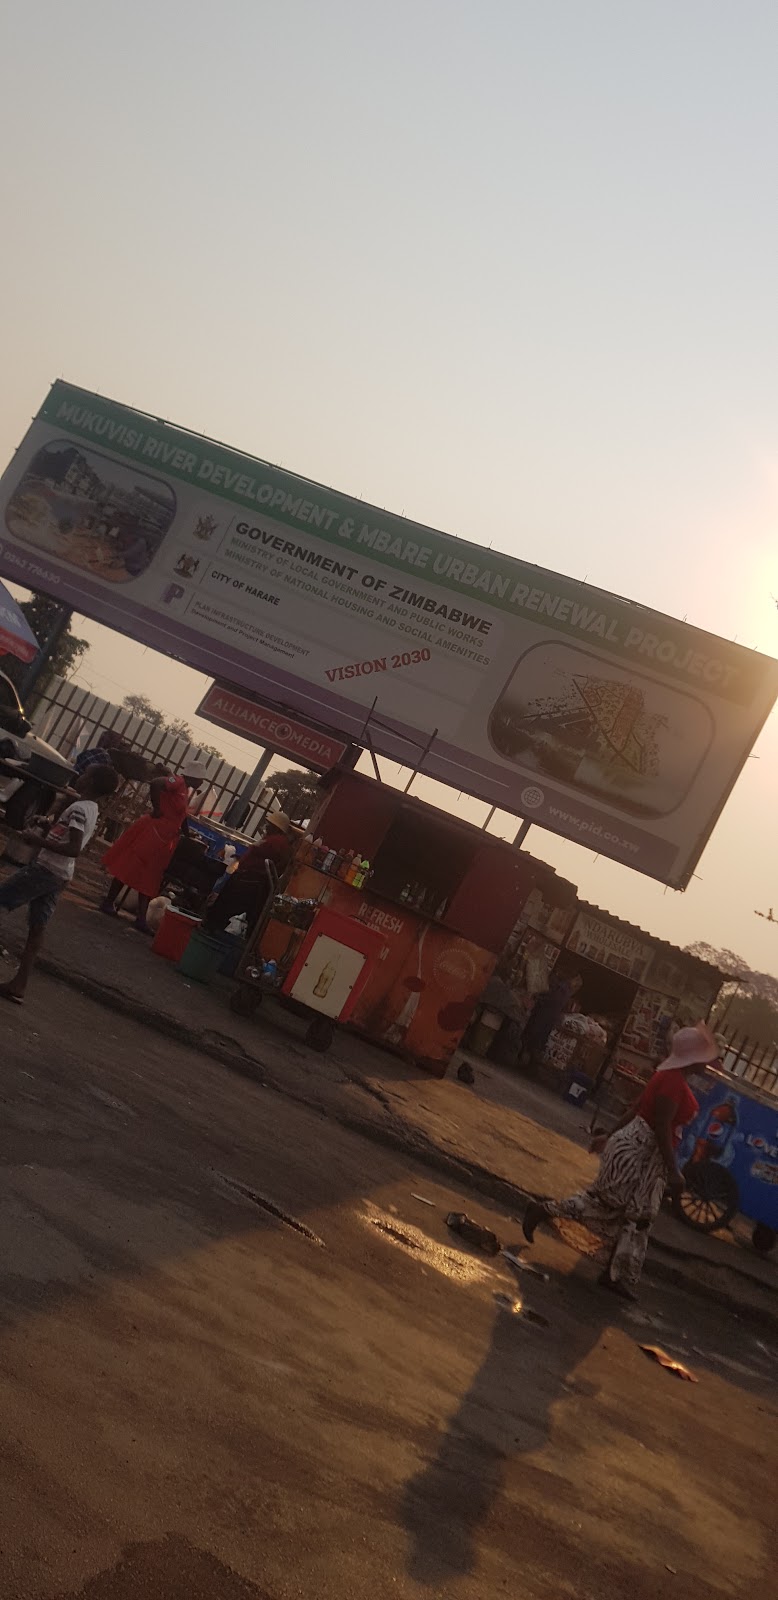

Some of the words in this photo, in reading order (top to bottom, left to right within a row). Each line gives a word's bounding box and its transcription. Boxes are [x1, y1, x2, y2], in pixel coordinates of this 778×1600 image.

[56, 401, 143, 450] MUKUVISI
[142, 436, 197, 472] RIVER
[197, 459, 339, 530] DEVELOPMENT
[338, 517, 355, 539] &
[357, 525, 432, 568] MBARE
[433, 552, 511, 598] URBAN
[510, 582, 619, 642] RENEWAL
[624, 626, 741, 688] PROJECT
[211, 570, 232, 584] CITY
[232, 579, 246, 590] OF
[245, 585, 280, 606] HARARE
[231, 537, 275, 560] MINISTRY
[276, 556, 290, 567] OF
[290, 561, 319, 581] LOCAL
[321, 576, 386, 608] GOVERNMENT
[387, 603, 408, 616] AND
[409, 612, 446, 632] PUBLIC
[447, 626, 484, 648] WORKS
[235, 522, 358, 580] GOVERNMENT
[361, 575, 387, 591] OF
[388, 585, 492, 635] ZIMBABWE
[191, 608, 227, 629] Development
[227, 624, 238, 633] and
[238, 629, 259, 643] Project
[259, 638, 295, 659] Management
[194, 601, 210, 612] PLAN
[211, 608, 265, 638] INFRASTRUCTURE
[266, 632, 310, 657] DEVELOPMENT
[224, 548, 269, 572] MINISTRY
[270, 568, 283, 579] OF
[284, 574, 329, 600] NATIONAL
[330, 594, 374, 618] HOUSING
[376, 614, 397, 627] AND
[398, 622, 433, 643] SOCIAL
[435, 638, 490, 666] AMENITIES
[325, 657, 387, 683] VISION
[391, 648, 431, 669] 2030
[213, 698, 276, 733] ALLIANCE
[290, 732, 332, 760] MEDIA
[549, 805, 640, 854] www.pid.co.zw
[358, 902, 405, 935] REFRESH
